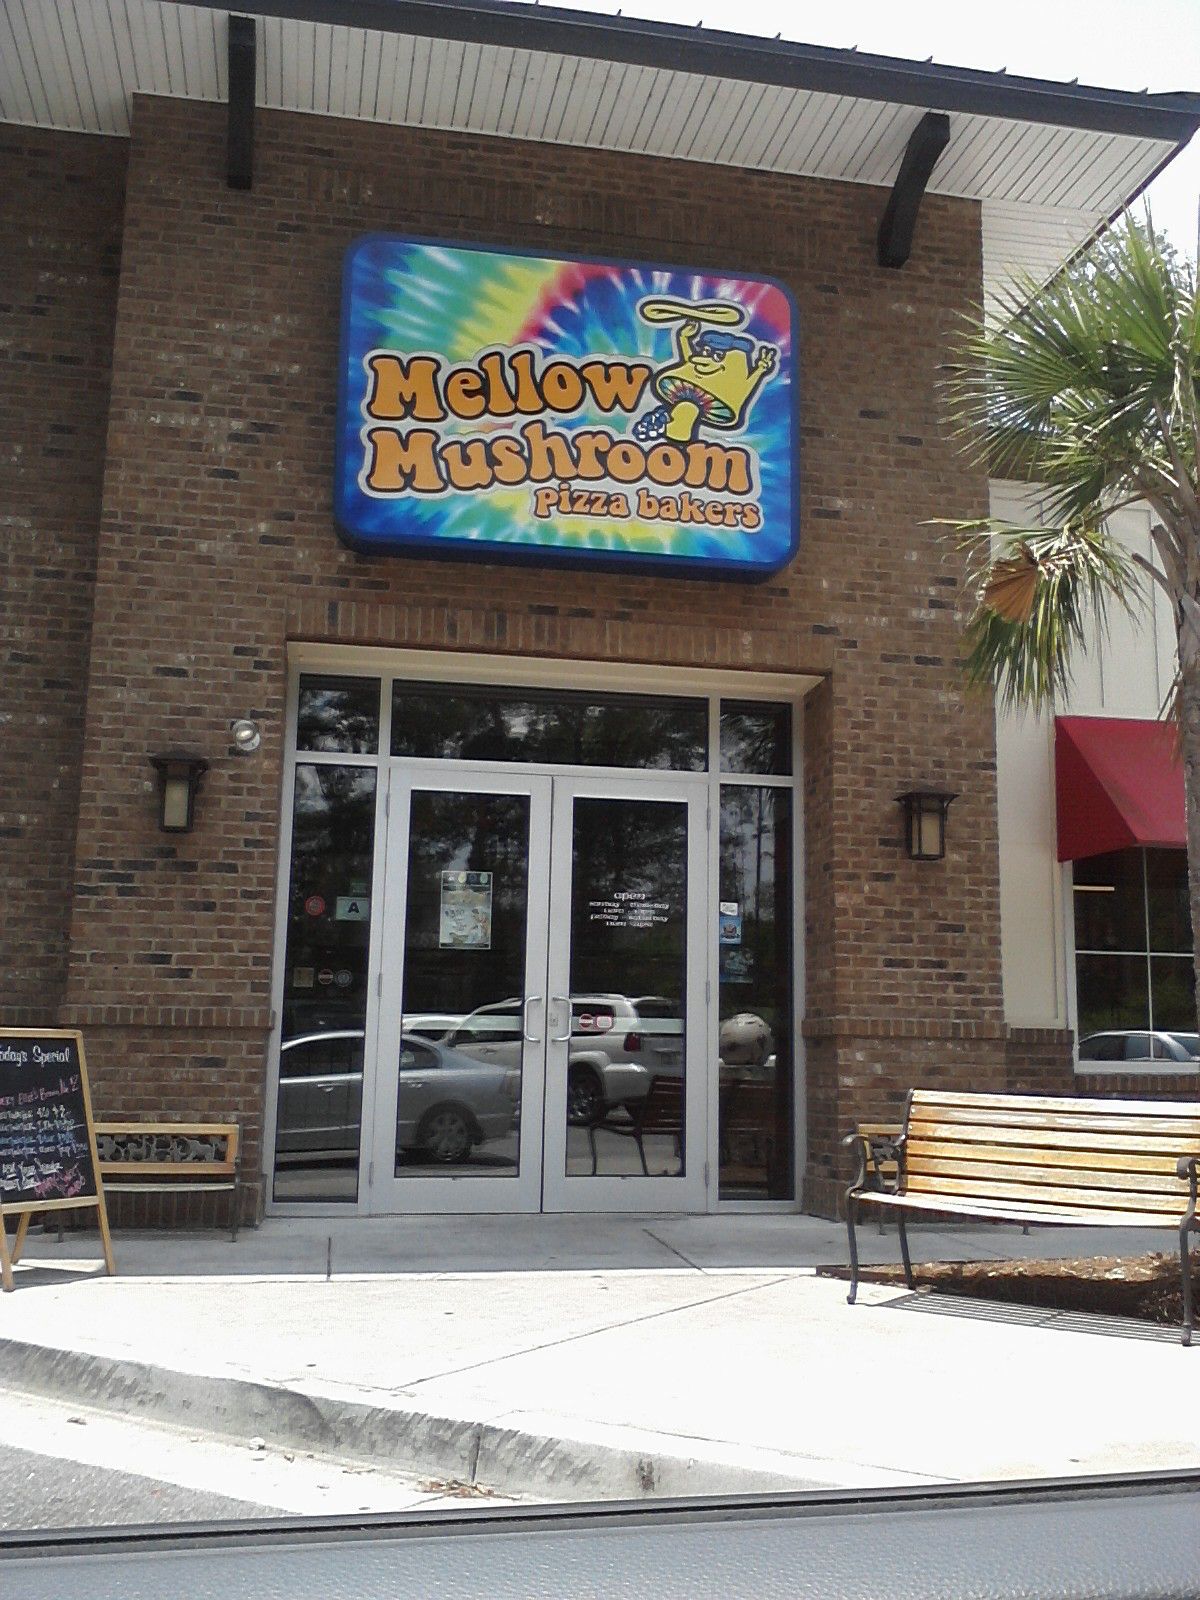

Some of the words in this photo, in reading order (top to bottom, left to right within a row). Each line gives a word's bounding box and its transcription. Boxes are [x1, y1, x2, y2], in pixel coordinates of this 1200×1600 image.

[366, 350, 651, 423] Mellow
[366, 420, 753, 496] Mushroom
[534, 482, 632, 519] pizza
[636, 487, 762, 529] bakers
[347, 901, 360, 914] A
